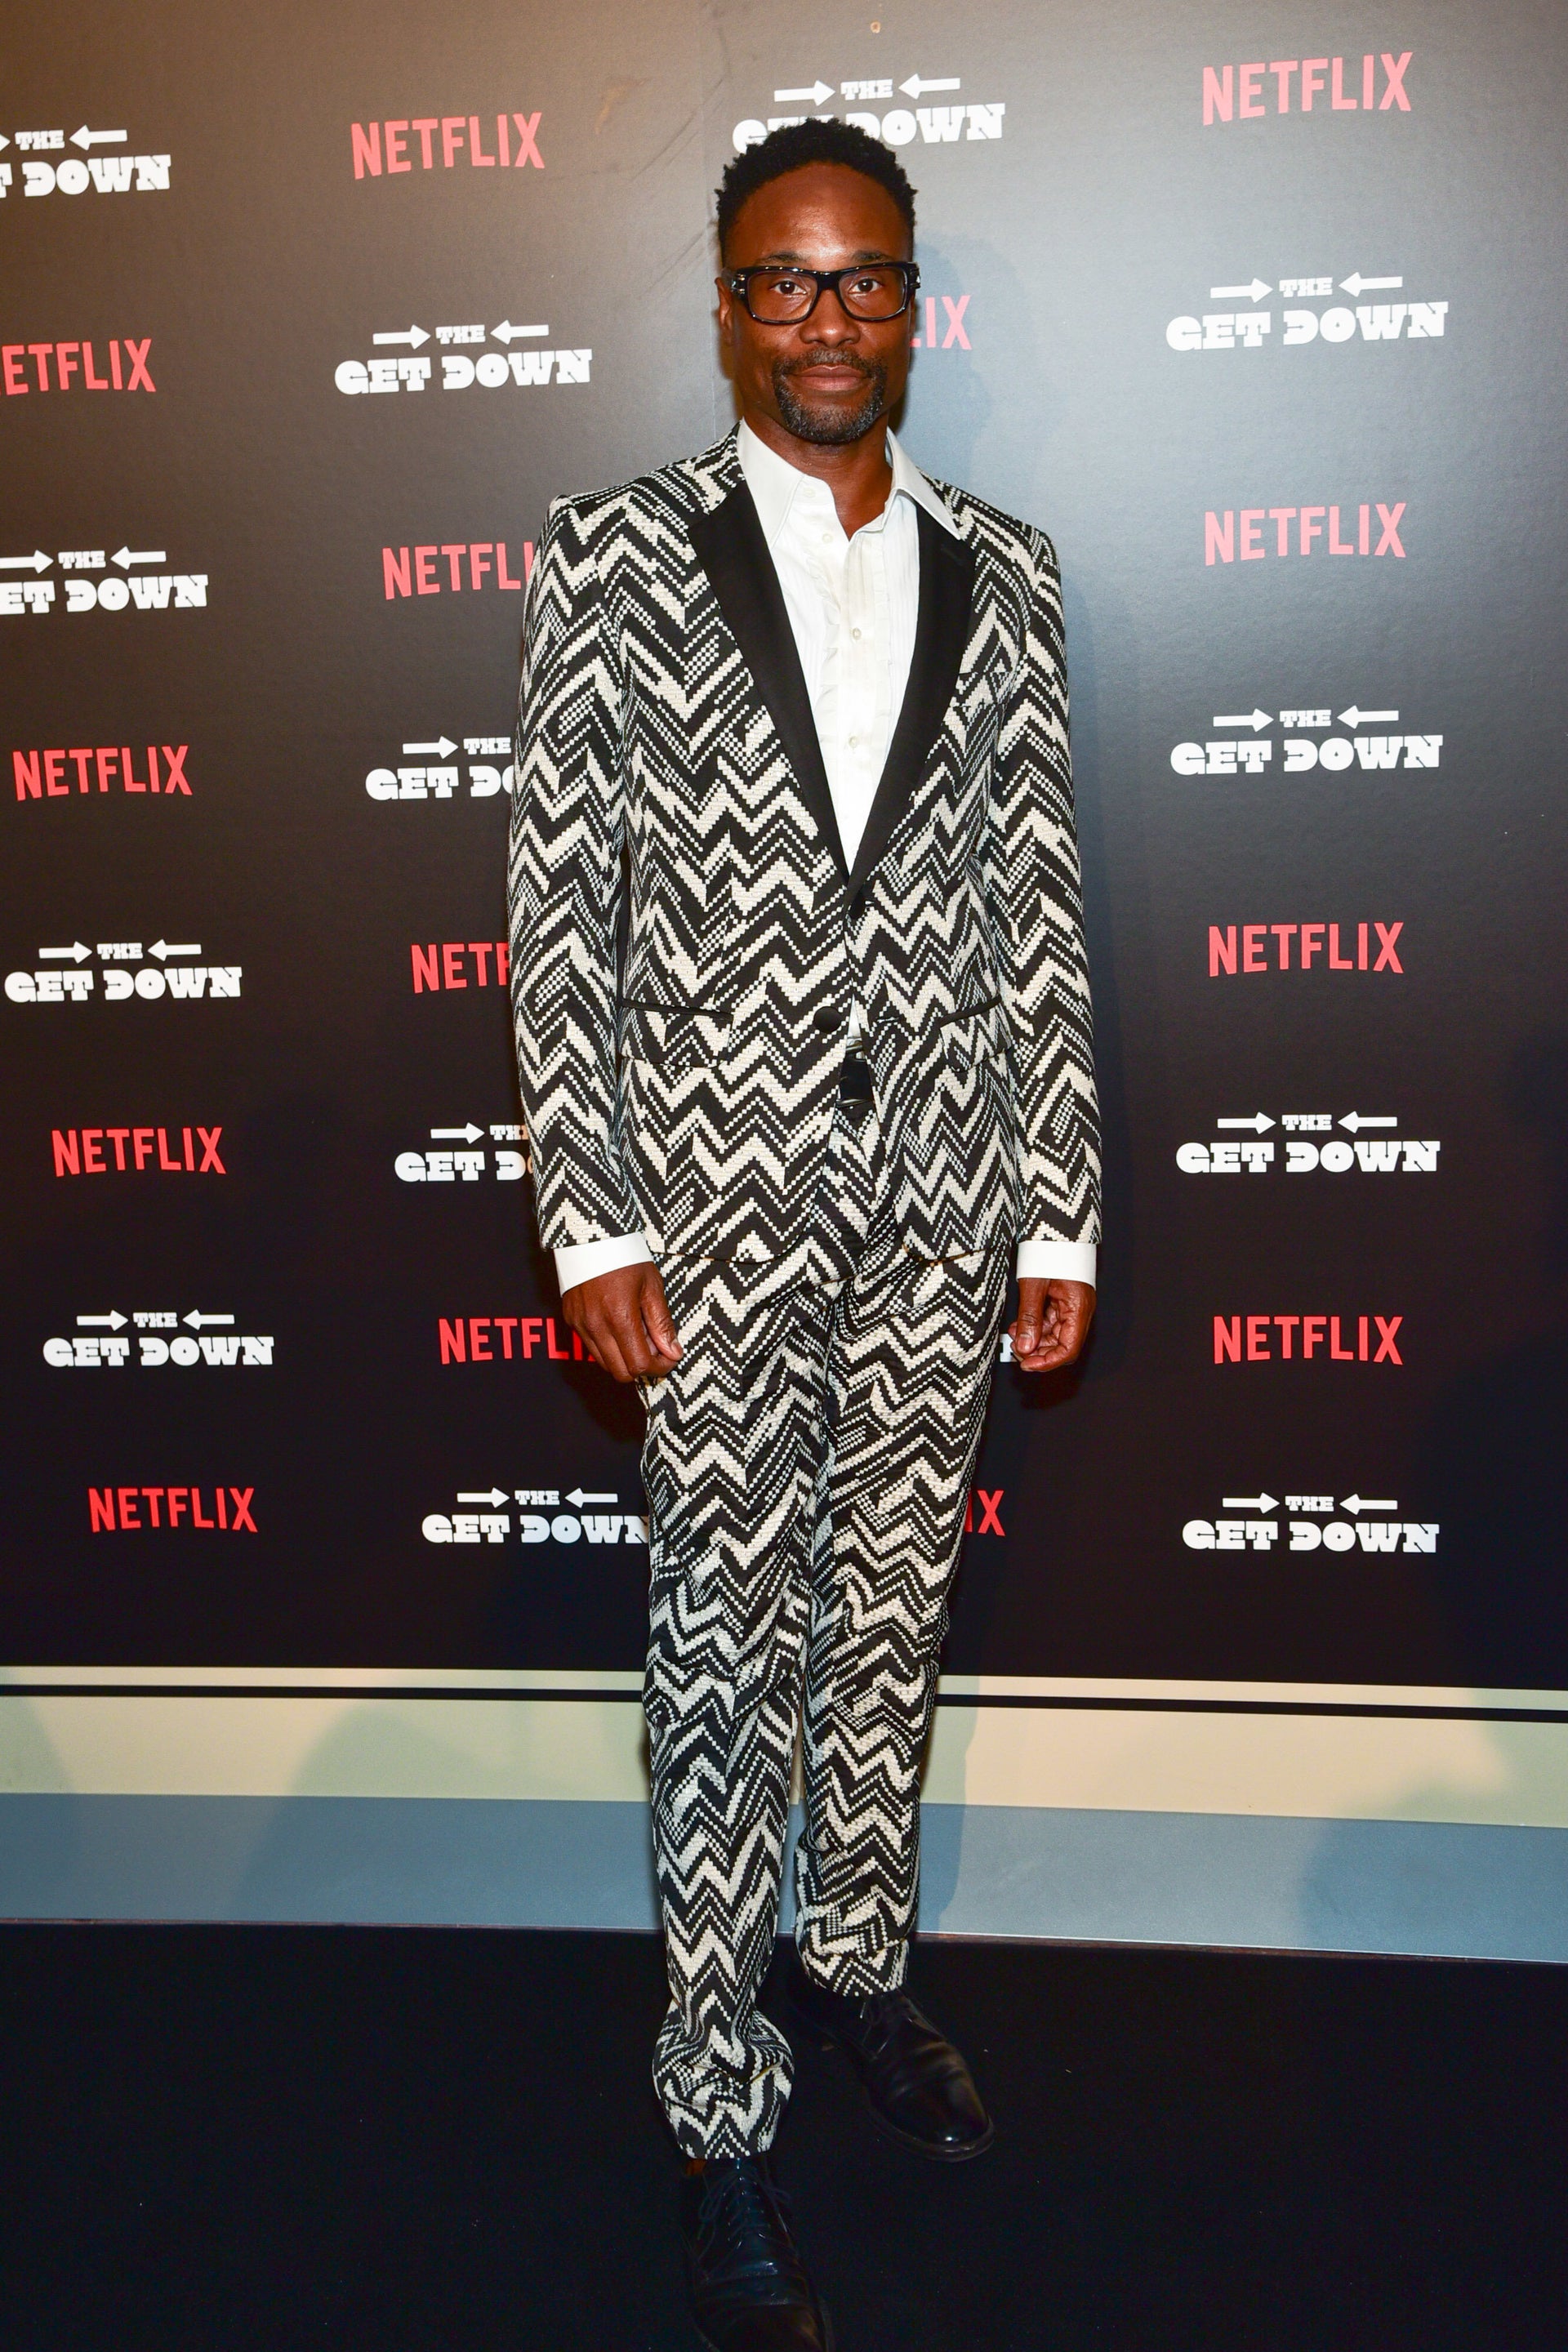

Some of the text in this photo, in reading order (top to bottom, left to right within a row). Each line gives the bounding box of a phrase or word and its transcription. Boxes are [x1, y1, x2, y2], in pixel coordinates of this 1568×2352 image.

[841, 79, 893, 100] THE
[1203, 51, 1412, 125] NETFLIX
[15, 130, 65, 150] THE
[350, 112, 544, 179] NETFLIX
[22, 154, 171, 196] DOWN
[1280, 278, 1332, 297] THE
[436, 325, 485, 344] THE
[1166, 301, 1448, 350] GET DOWN
[1, 338, 156, 395] ETFLIX
[335, 349, 592, 394] GET DOWN
[1205, 502, 1406, 565] NETFLIX
[58, 550, 105, 568] THE
[382, 541, 533, 600] NETFLI
[0, 575, 208, 614] ET DOWN
[1280, 710, 1331, 728] THE
[464, 737, 511, 755] THE
[1171, 735, 1443, 775] GET DOWN
[12, 745, 193, 801] NETFLIX
[366, 767, 458, 800] GET
[97, 943, 143, 960] THE
[1209, 921, 1403, 977] NETFLIX
[5, 967, 242, 1002] GET DOWN
[412, 942, 510, 994] NETF
[1282, 1115, 1331, 1130] THE
[51, 1126, 226, 1177] NETFLIX
[395, 1152, 485, 1182] GET
[1176, 1141, 1440, 1173] GET DOWN
[133, 1312, 177, 1327] THE
[43, 1337, 274, 1366] GET DOWN
[439, 1317, 595, 1365] NETFLI
[1214, 1315, 1402, 1365] NETFLIX
[88, 1487, 257, 1532] NETFLIX
[515, 1490, 559, 1505] THE
[1285, 1496, 1334, 1511] THE
[422, 1515, 510, 1543] GET
[1183, 1520, 1439, 1552] GET DOWN
